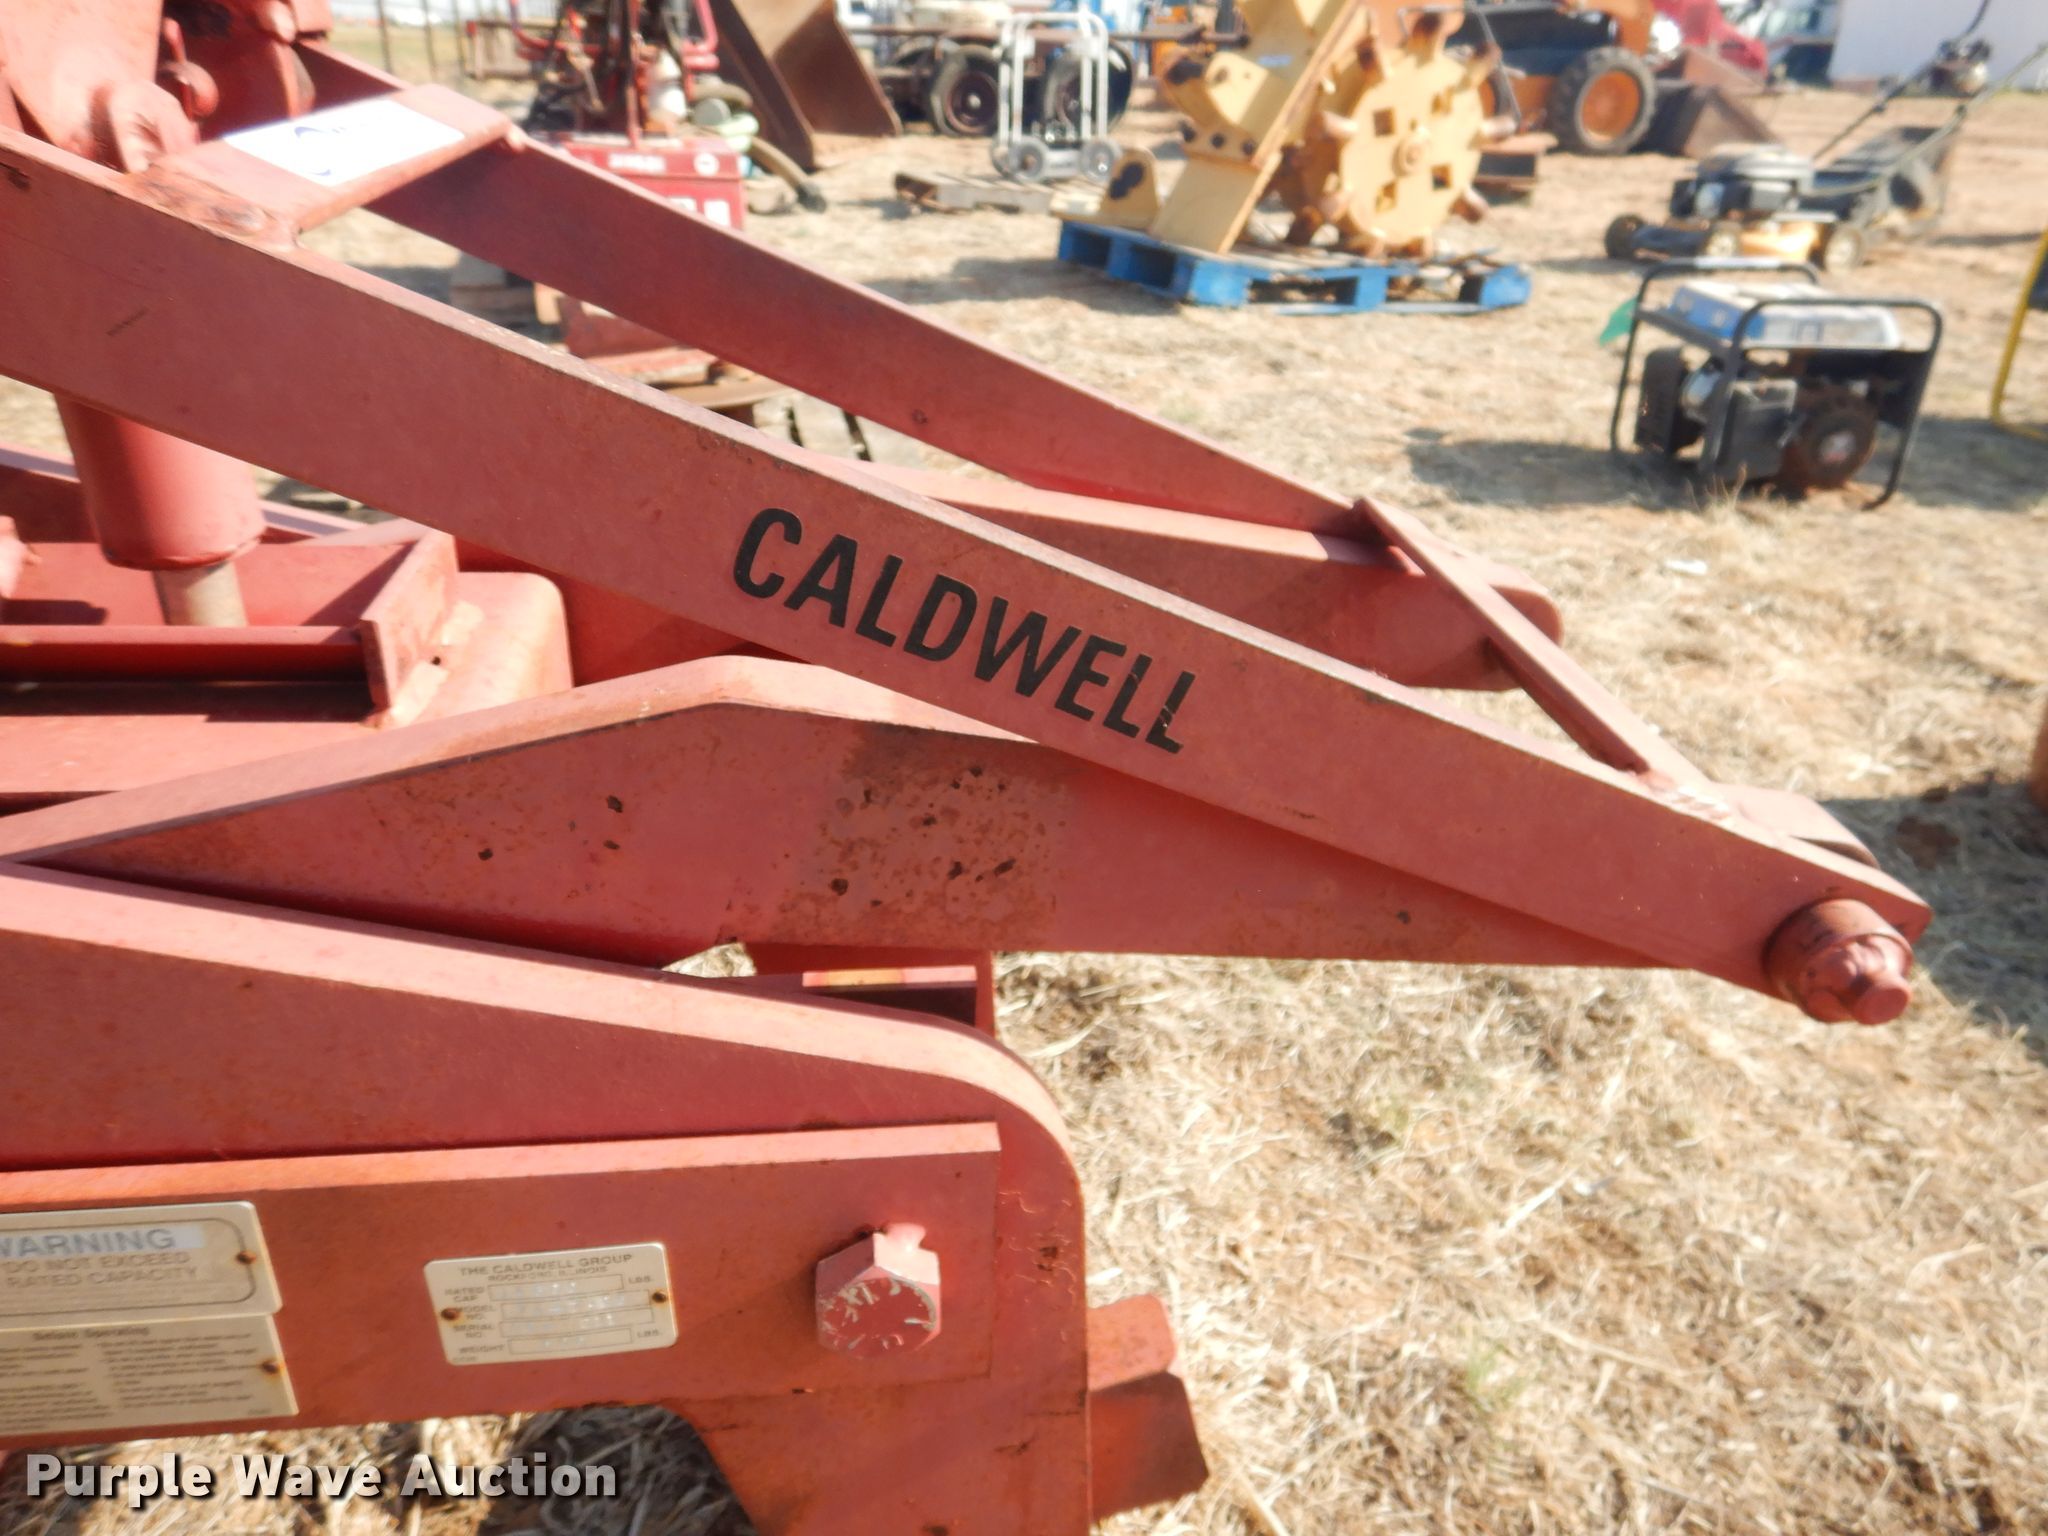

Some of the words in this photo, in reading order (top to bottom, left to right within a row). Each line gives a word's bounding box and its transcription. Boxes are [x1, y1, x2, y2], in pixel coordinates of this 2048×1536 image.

[733, 508, 1196, 754] CALDWELL
[45, 1256, 91, 1270] NOT
[99, 1251, 190, 1268] EXCEED
[459, 1267, 488, 1276] THE
[492, 1260, 574, 1274] CALDWELL
[578, 1254, 632, 1266] GROUP
[7, 1273, 82, 1288] RATED
[88, 1265, 197, 1284] CAPACITY
